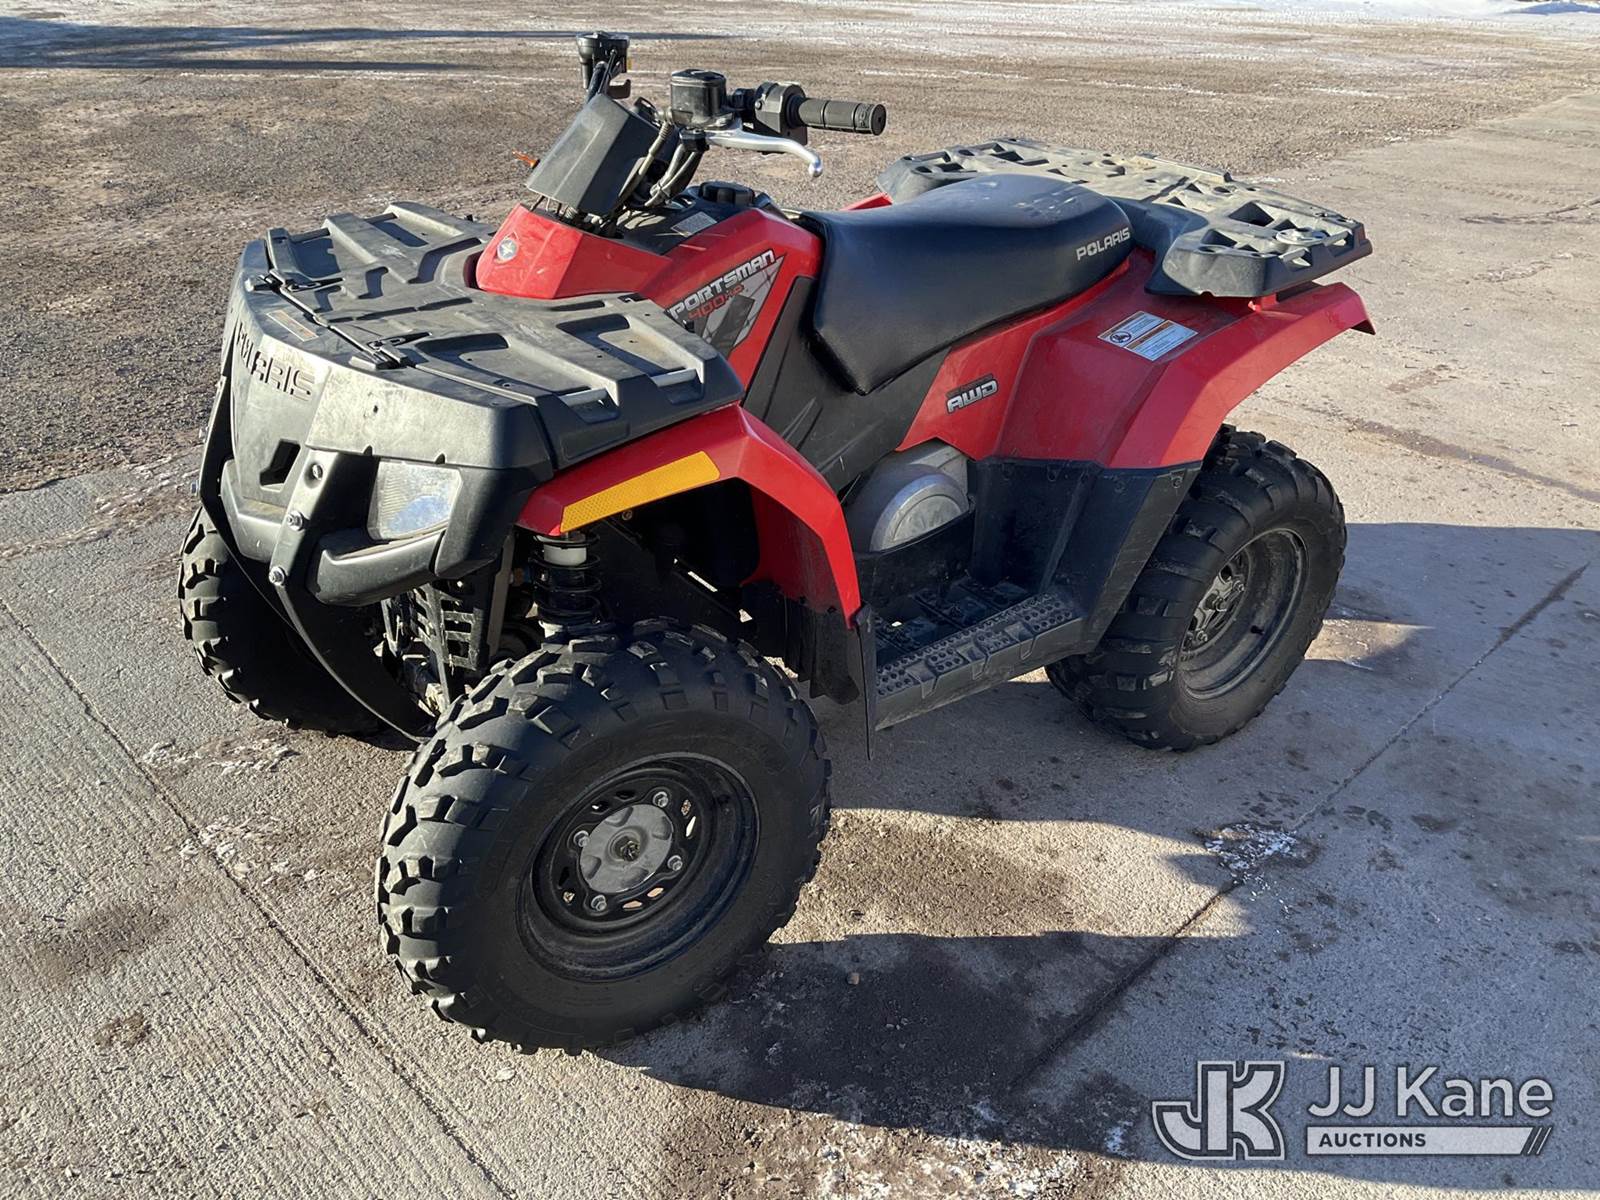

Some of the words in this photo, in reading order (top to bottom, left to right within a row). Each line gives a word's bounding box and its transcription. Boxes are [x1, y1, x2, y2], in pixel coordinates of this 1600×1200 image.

[1076, 227, 1131, 261] POLARIS
[666, 249, 775, 320] PORTSMAN
[947, 380, 998, 413] AWD
